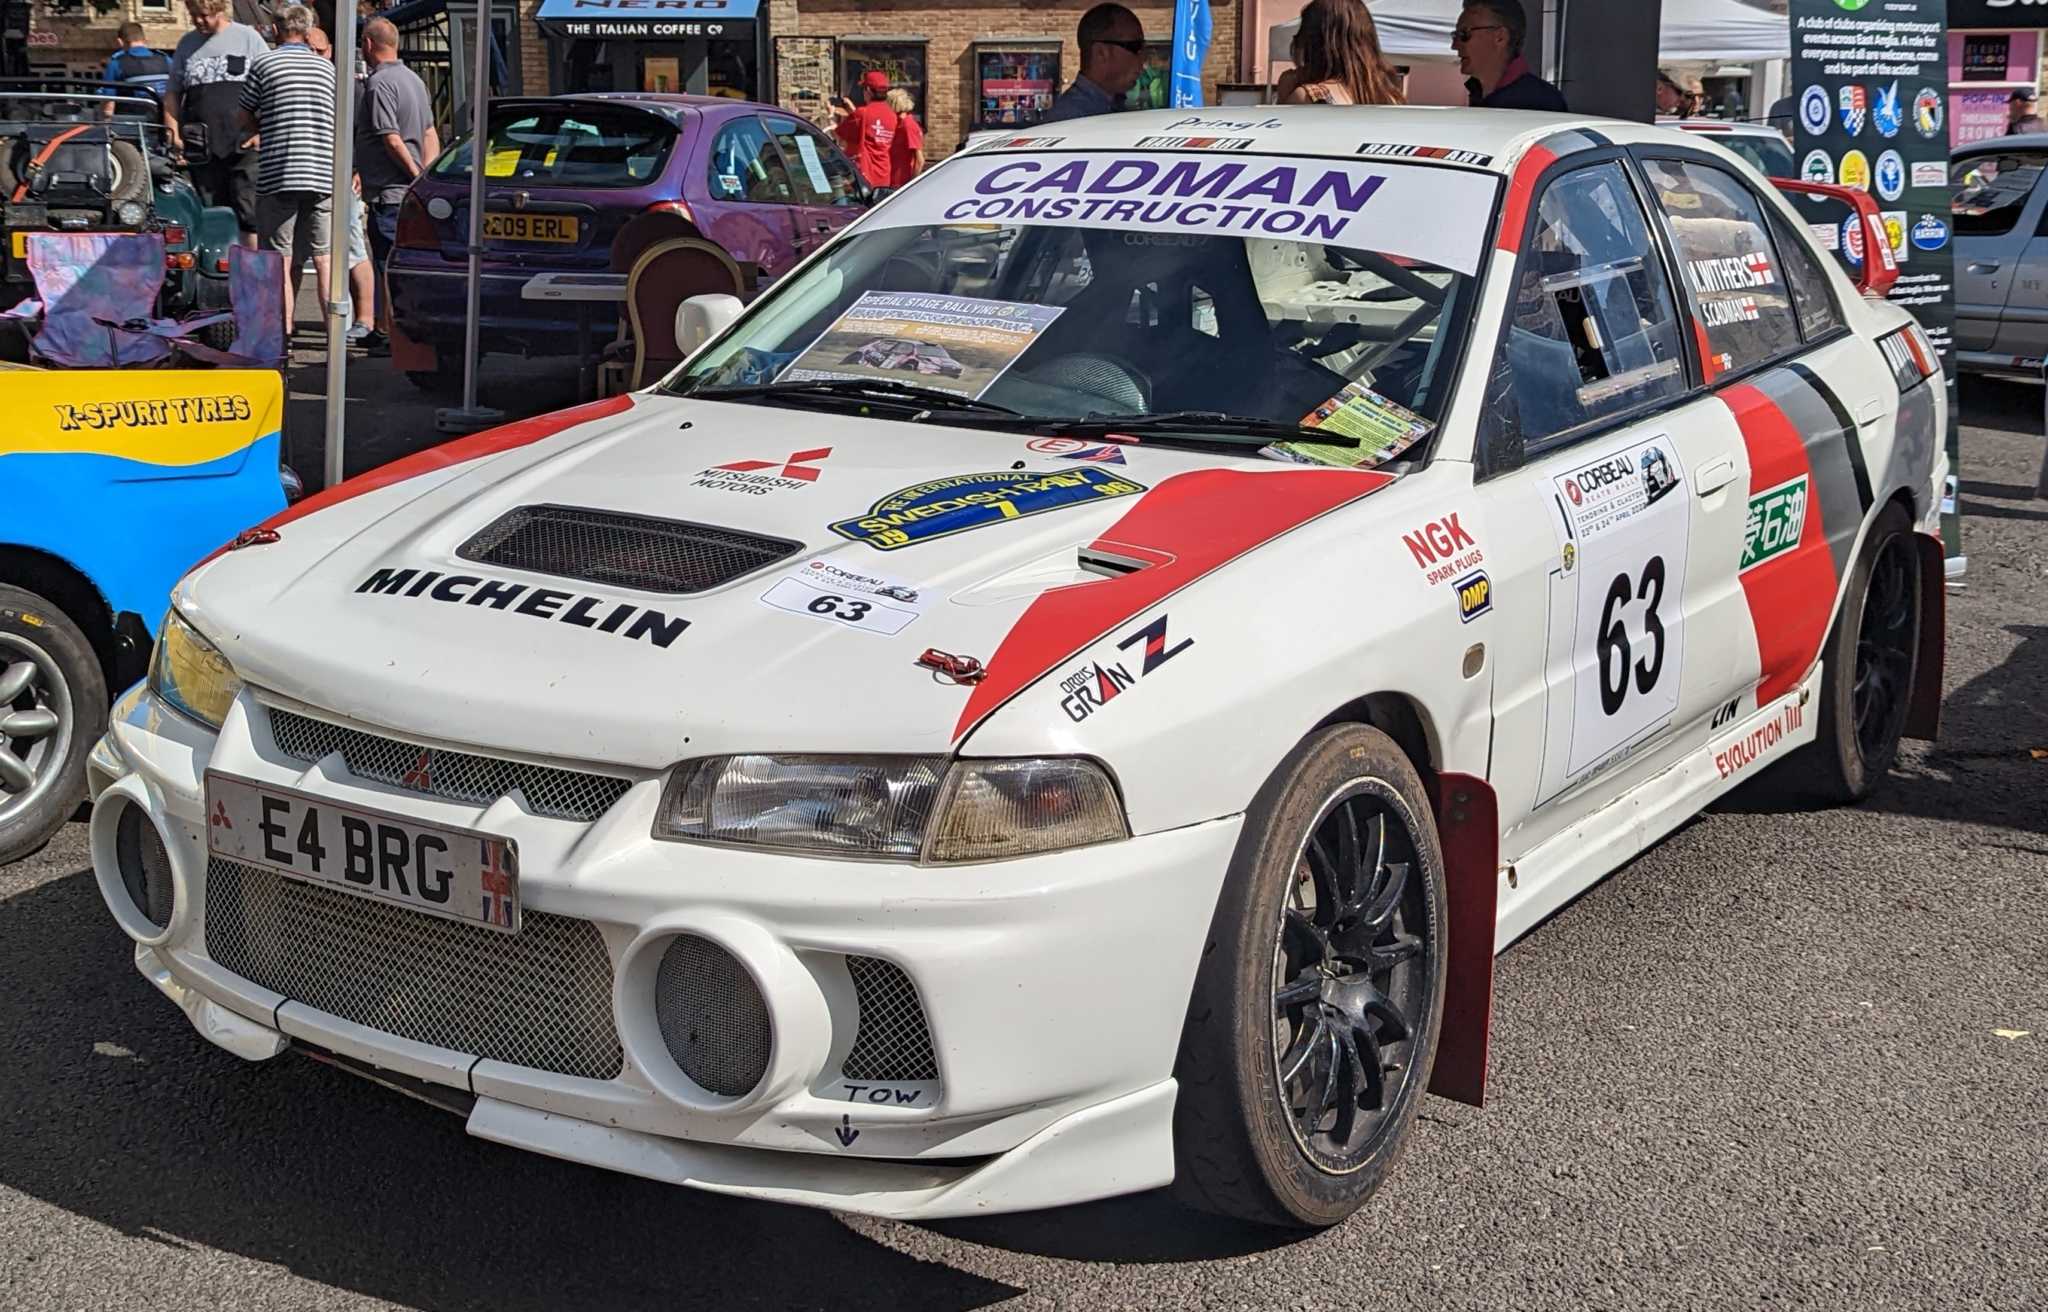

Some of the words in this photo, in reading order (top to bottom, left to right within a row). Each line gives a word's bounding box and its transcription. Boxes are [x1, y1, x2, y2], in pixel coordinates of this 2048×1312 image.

[567, 24, 590, 34] THE
[596, 24, 647, 34] ITALIAN
[653, 24, 701, 34] COFFEE
[1797, 16, 1806, 28] A
[1806, 16, 1824, 29] club
[1824, 17, 1834, 29] of
[1833, 17, 1856, 30] clubs
[1856, 19, 1895, 33] organising
[1803, 32, 1830, 44] events
[1830, 34, 1857, 45] across
[1857, 34, 1874, 46] East
[1900, 35, 1909, 46] A
[1909, 35, 1924, 47] role
[1924, 35, 1937, 47] for
[1801, 48, 1839, 61] everyone
[1839, 48, 1855, 59] and
[1855, 48, 1866, 60] all
[1866, 50, 1880, 60] are
[1824, 62, 1841, 74] and
[1841, 62, 1852, 74] be
[1852, 64, 1869, 77] part
[1869, 63, 1879, 75] of
[1879, 63, 1891, 75] the
[1164, 116, 1282, 132] Pringle
[974, 159, 1388, 212] CADMAN
[532, 218, 571, 239] ERL
[943, 198, 1350, 240] CONSTRUCTION
[860, 295, 902, 307] SPECIAL
[904, 297, 942, 311] STAGE
[942, 301, 1000, 316] RALLYING
[54, 402, 168, 431] X-SPURT
[170, 395, 251, 423] TYRES
[690, 478, 773, 496] MOTORS
[695, 469, 808, 490] MITSUBISHI
[1577, 455, 1634, 493] CORBEAU
[858, 486, 1023, 533] SWEDISH
[1012, 470, 1093, 494] RALLY
[1092, 481, 1135, 497] 96
[1402, 511, 1475, 569] NGK
[824, 564, 884, 586] CORBEAU
[1426, 562, 1458, 586] SPARK
[1454, 549, 1484, 572] PLUGS
[354, 567, 692, 649] MICHELIN
[807, 595, 872, 622] 63
[1462, 580, 1489, 612] OMP
[1597, 555, 1666, 717] 63
[1059, 666, 1095, 694] ORBIS
[1711, 695, 1742, 731] LIN
[1715, 716, 1783, 780] EVOLUTION
[259, 796, 327, 873] E4
[342, 815, 454, 904] BRG
[843, 1084, 922, 1104] TOW
